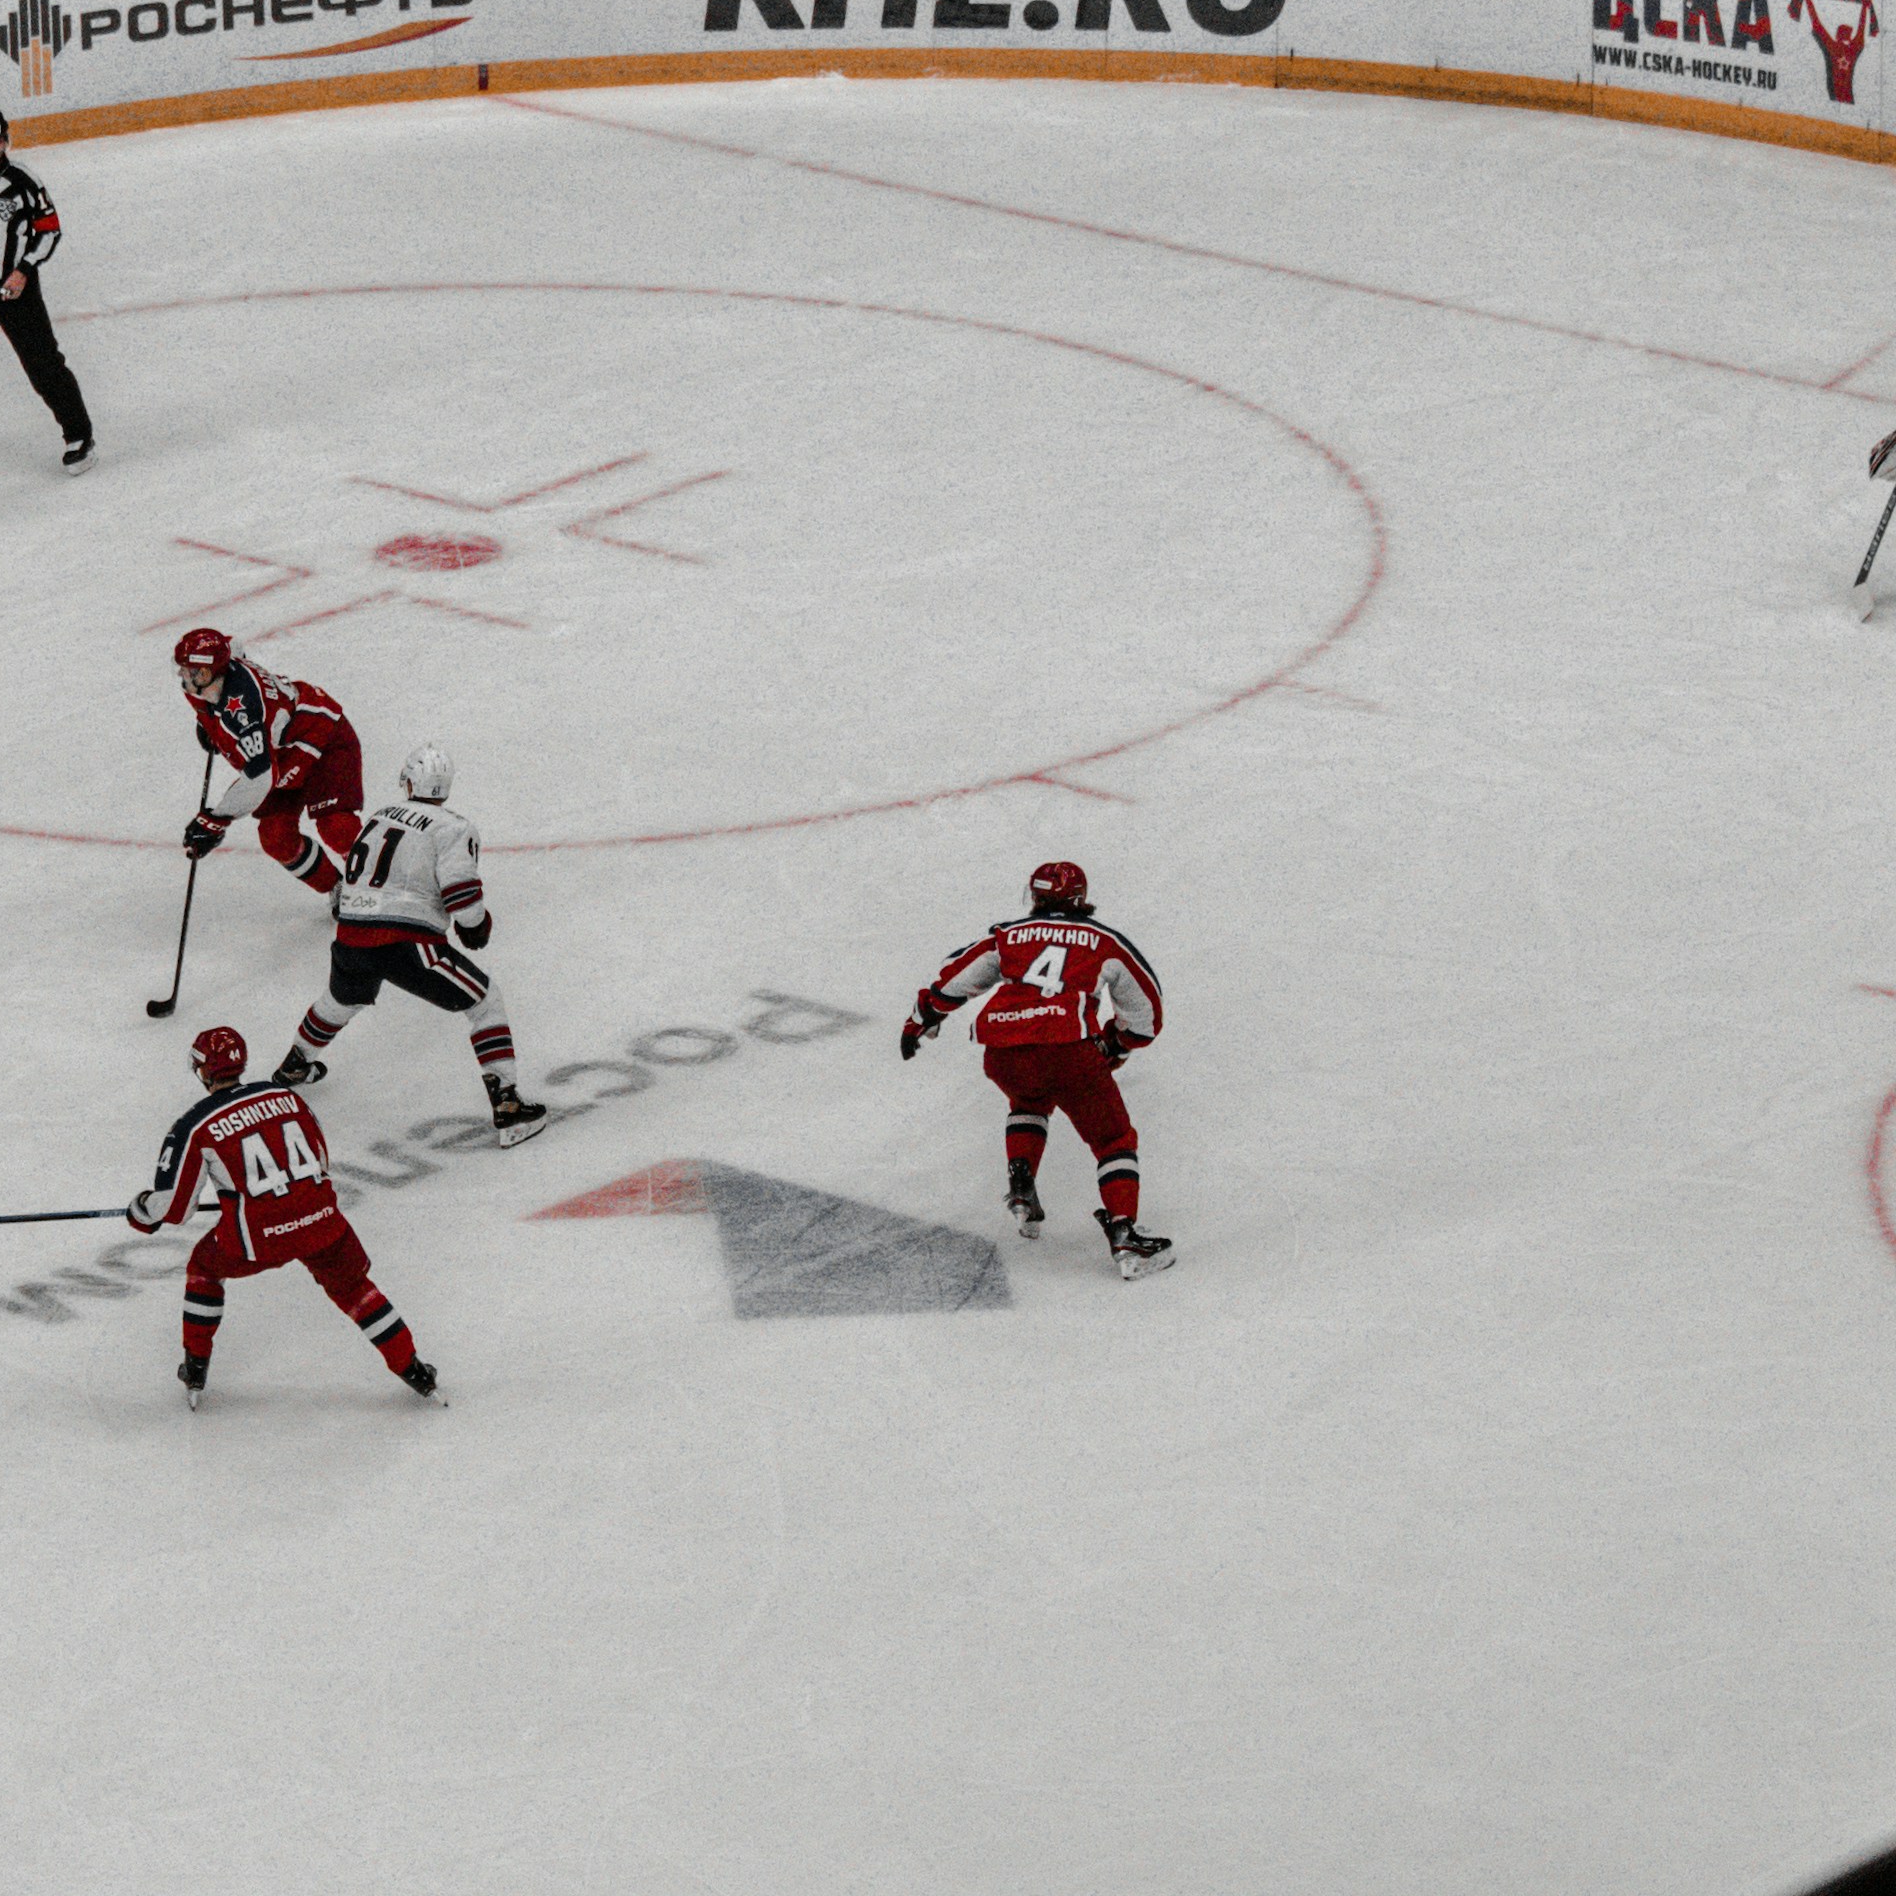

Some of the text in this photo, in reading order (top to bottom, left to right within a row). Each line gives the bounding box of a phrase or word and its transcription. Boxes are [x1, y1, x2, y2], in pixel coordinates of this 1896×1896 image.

[1592, 43, 1777, 92] WWW.CSKA-HOCKEY.RU
[240, 730, 265, 759] 88
[345, 818, 406, 889] 61
[1006, 926, 1101, 952] CHMYKHOV
[1023, 943, 1070, 999] 4
[987, 1004, 1067, 1024] РОСНЕФТЬ
[207, 1094, 300, 1143] SOSHNIKOV
[241, 1120, 324, 1199] 44
[262, 1205, 336, 1239] РОСНЕФТЬ
